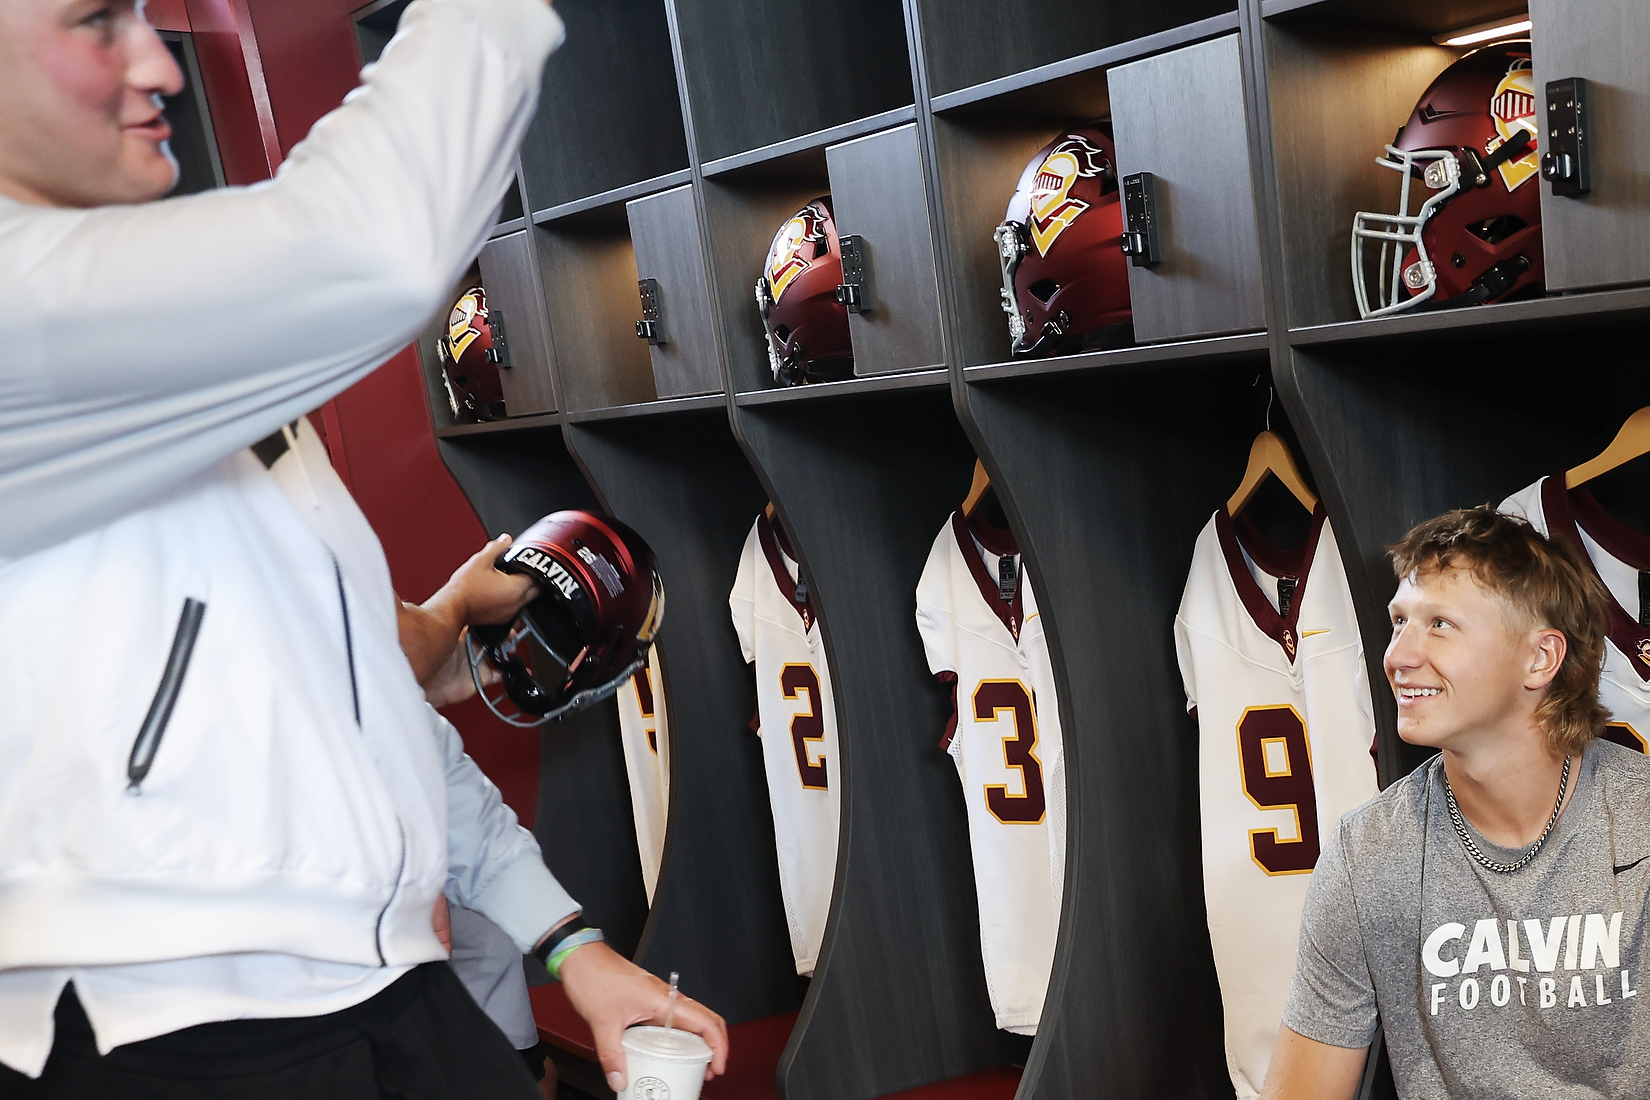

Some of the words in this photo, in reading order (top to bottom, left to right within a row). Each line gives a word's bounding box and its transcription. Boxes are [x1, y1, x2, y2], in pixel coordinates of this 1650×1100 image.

[516, 548, 580, 597] CALVIN
[779, 662, 829, 792] 2
[1235, 703, 1321, 877] 9
[1421, 911, 1624, 977] CALVIN
[1429, 969, 1638, 1016] FOOTBALL
